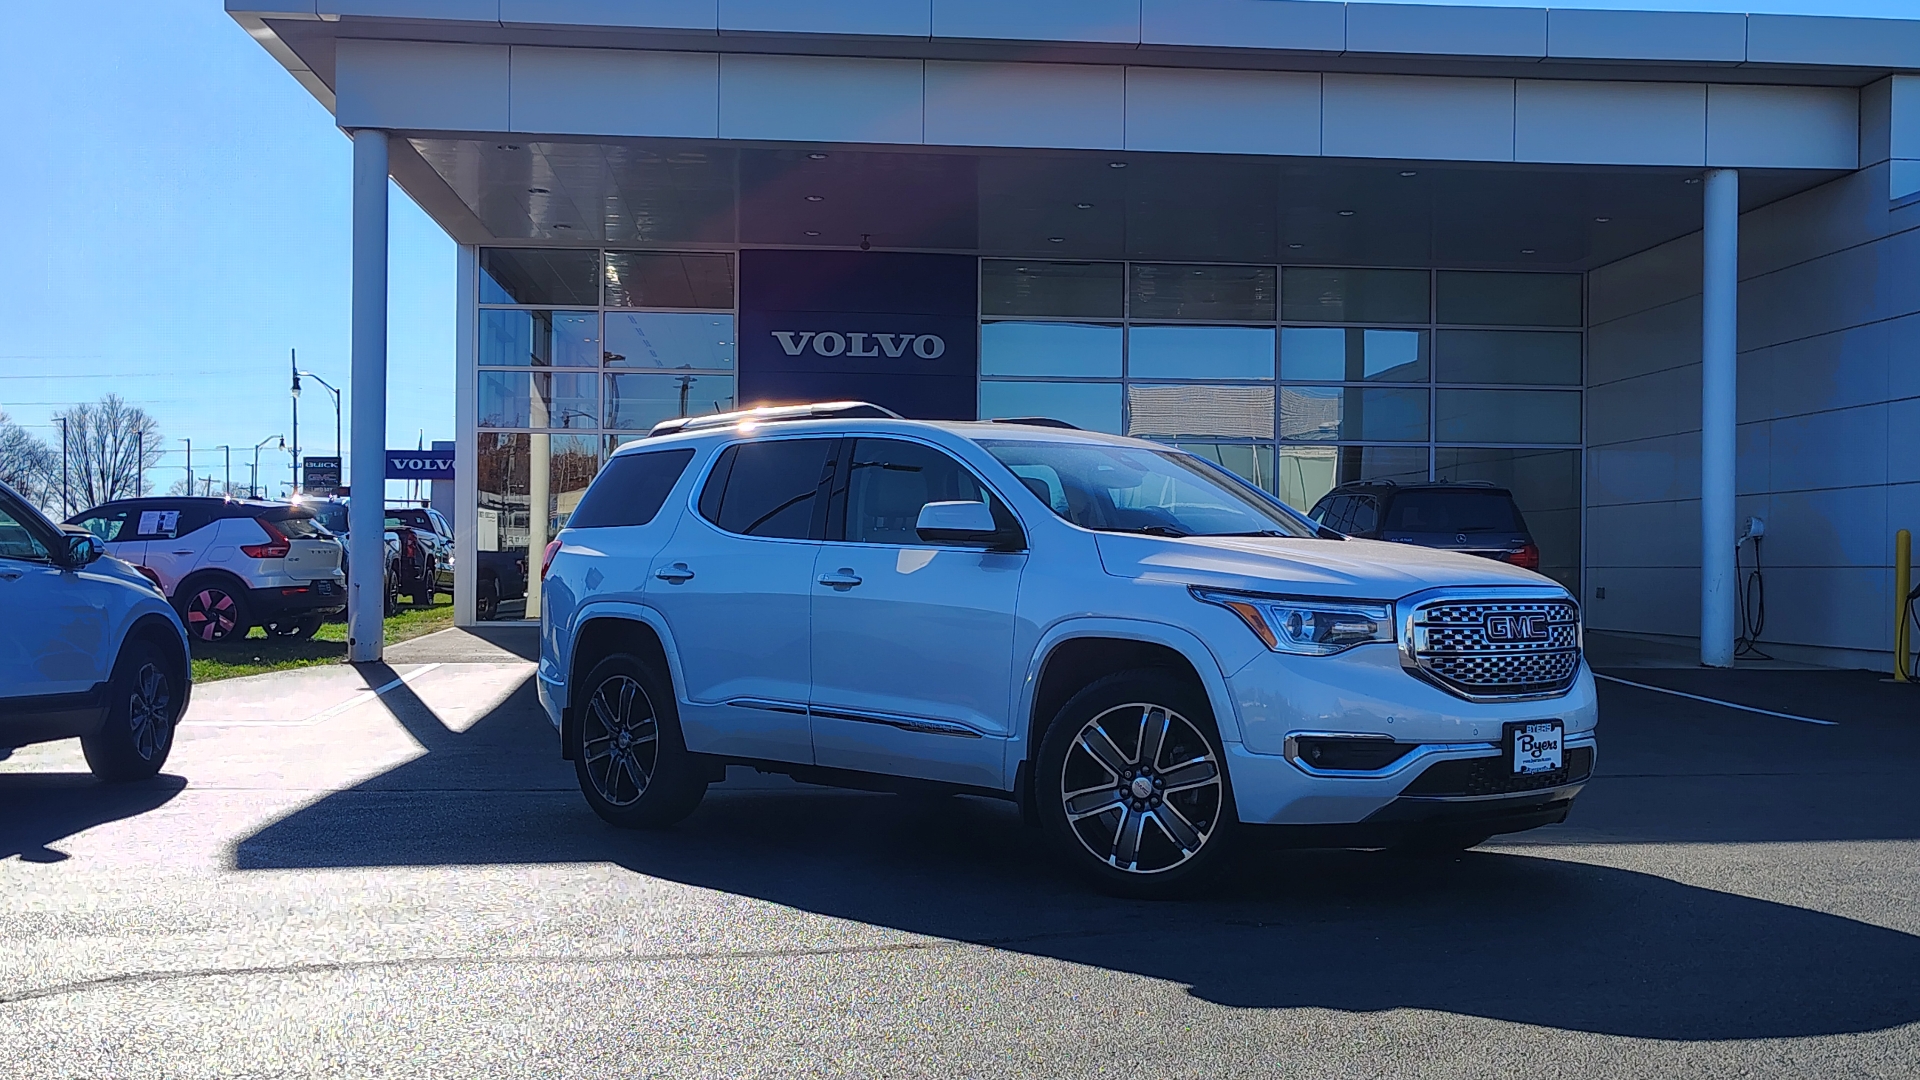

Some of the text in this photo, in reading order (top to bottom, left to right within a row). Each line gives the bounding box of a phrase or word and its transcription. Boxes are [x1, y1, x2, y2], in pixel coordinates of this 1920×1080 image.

[771, 331, 945, 359] VOLVO
[391, 458, 455, 470] VOLV
[307, 473, 337, 481] GMC
[1487, 615, 1547, 639] GMC
[1516, 734, 1558, 758] Byers
